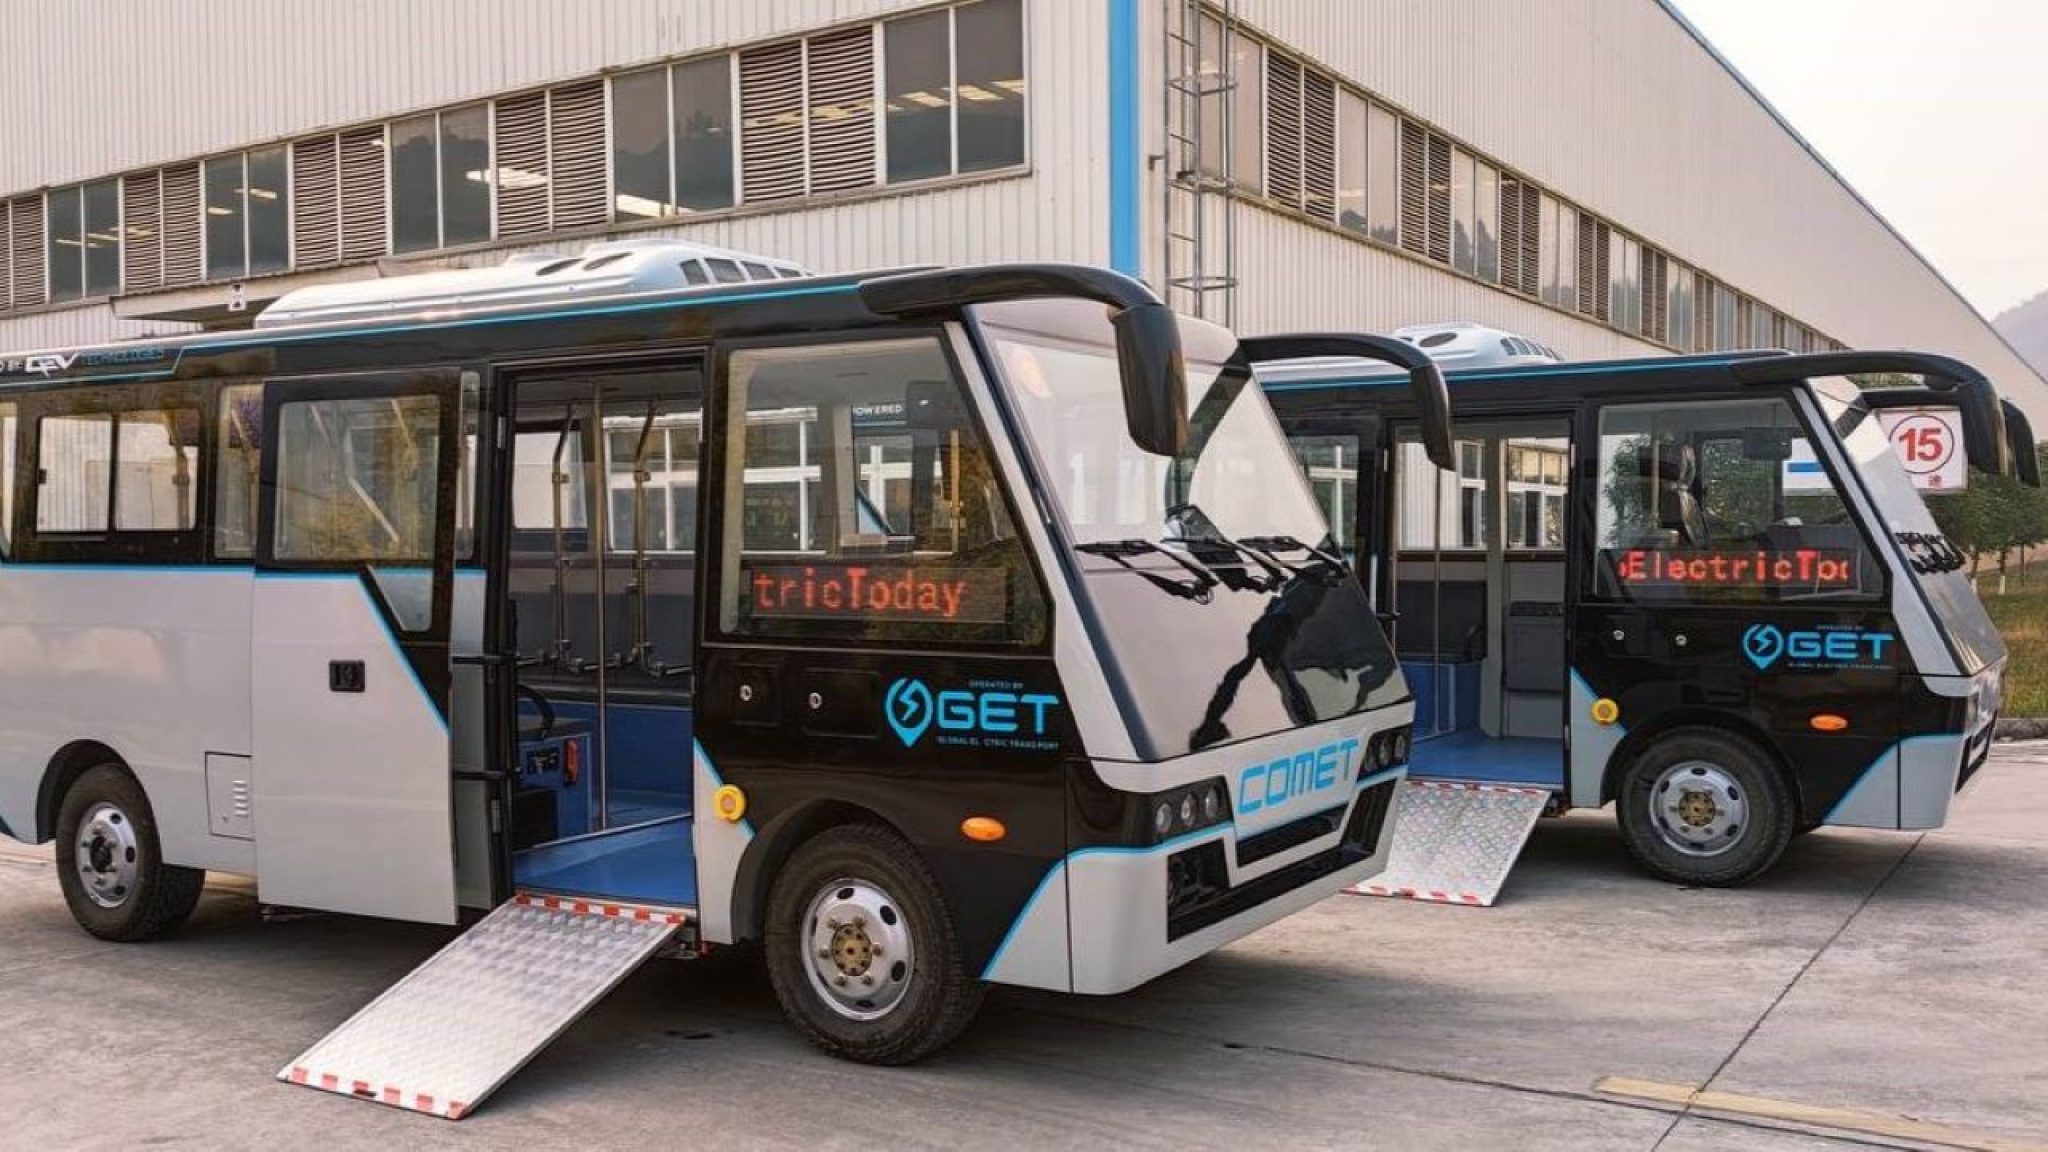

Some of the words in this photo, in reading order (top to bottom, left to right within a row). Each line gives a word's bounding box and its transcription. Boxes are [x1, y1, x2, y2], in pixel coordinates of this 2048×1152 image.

[1898, 428, 1944, 462] 15
[753, 565, 969, 618] tricToday
[1787, 631, 1894, 660] GET
[938, 690, 1059, 734] GET
[1237, 738, 1359, 814] COMET
